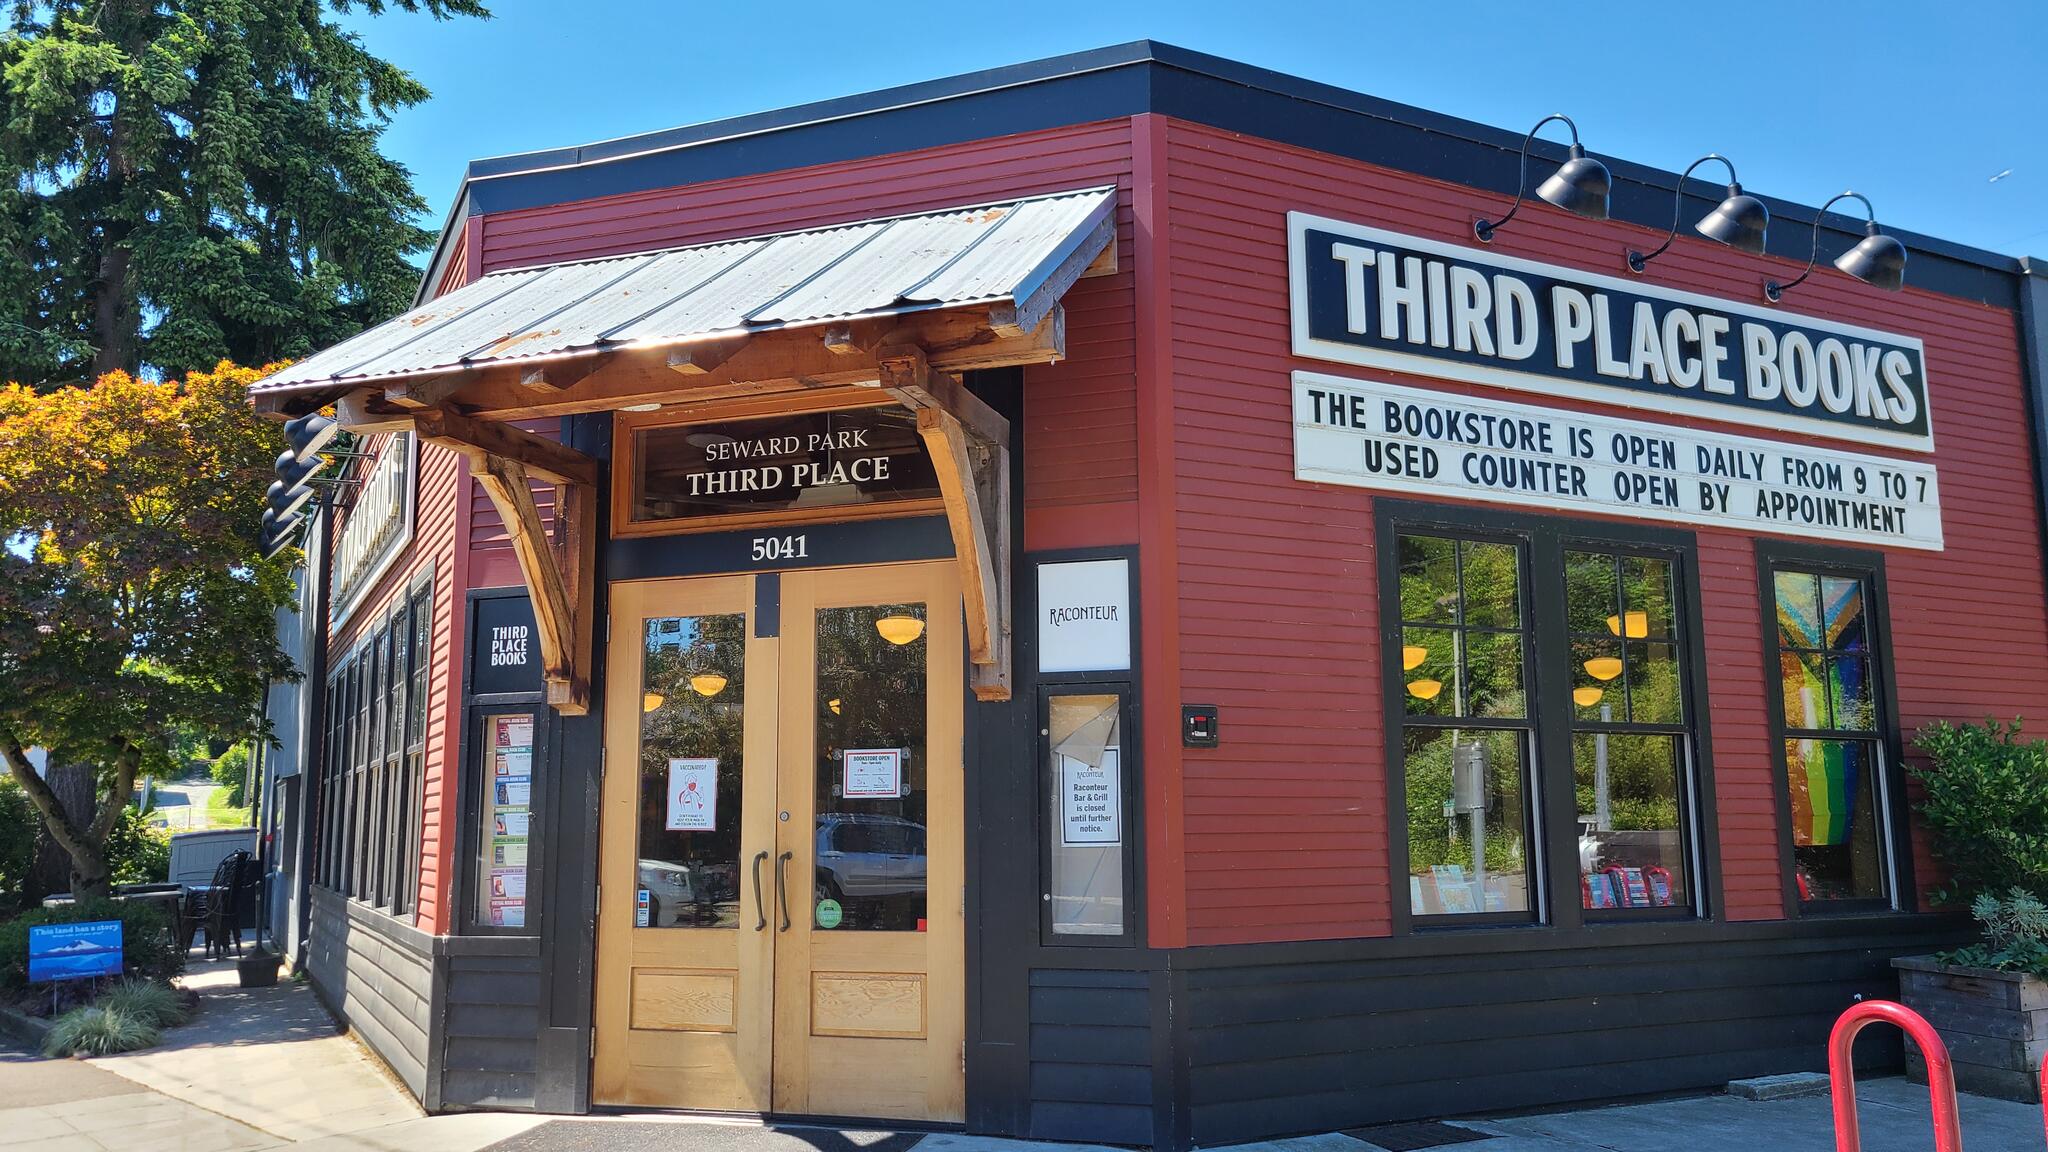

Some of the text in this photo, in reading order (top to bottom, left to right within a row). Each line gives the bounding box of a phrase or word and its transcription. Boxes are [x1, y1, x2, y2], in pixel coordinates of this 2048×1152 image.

[1332, 242, 1916, 424] THIRD PLACE BOOKS
[706, 429, 868, 461] SEWARD PARK
[1308, 389, 1926, 502] THE BOOKSTORE IS OPEN DAILY FROM 9 TO 7
[686, 456, 889, 496] THIRD PLACE
[1364, 439, 1905, 534] USED COUNTER OPEN BY APPOINTMENT
[752, 534, 808, 561] 5041
[1050, 605, 1118, 626] RACONTEUR
[492, 626, 528, 640] THIRD
[492, 639, 527, 652] PLACE
[491, 652, 527, 666] BOOKS
[1077, 772, 1104, 780] RACONTEUR
[34, 928, 54, 936] This
[55, 926, 73, 934] land
